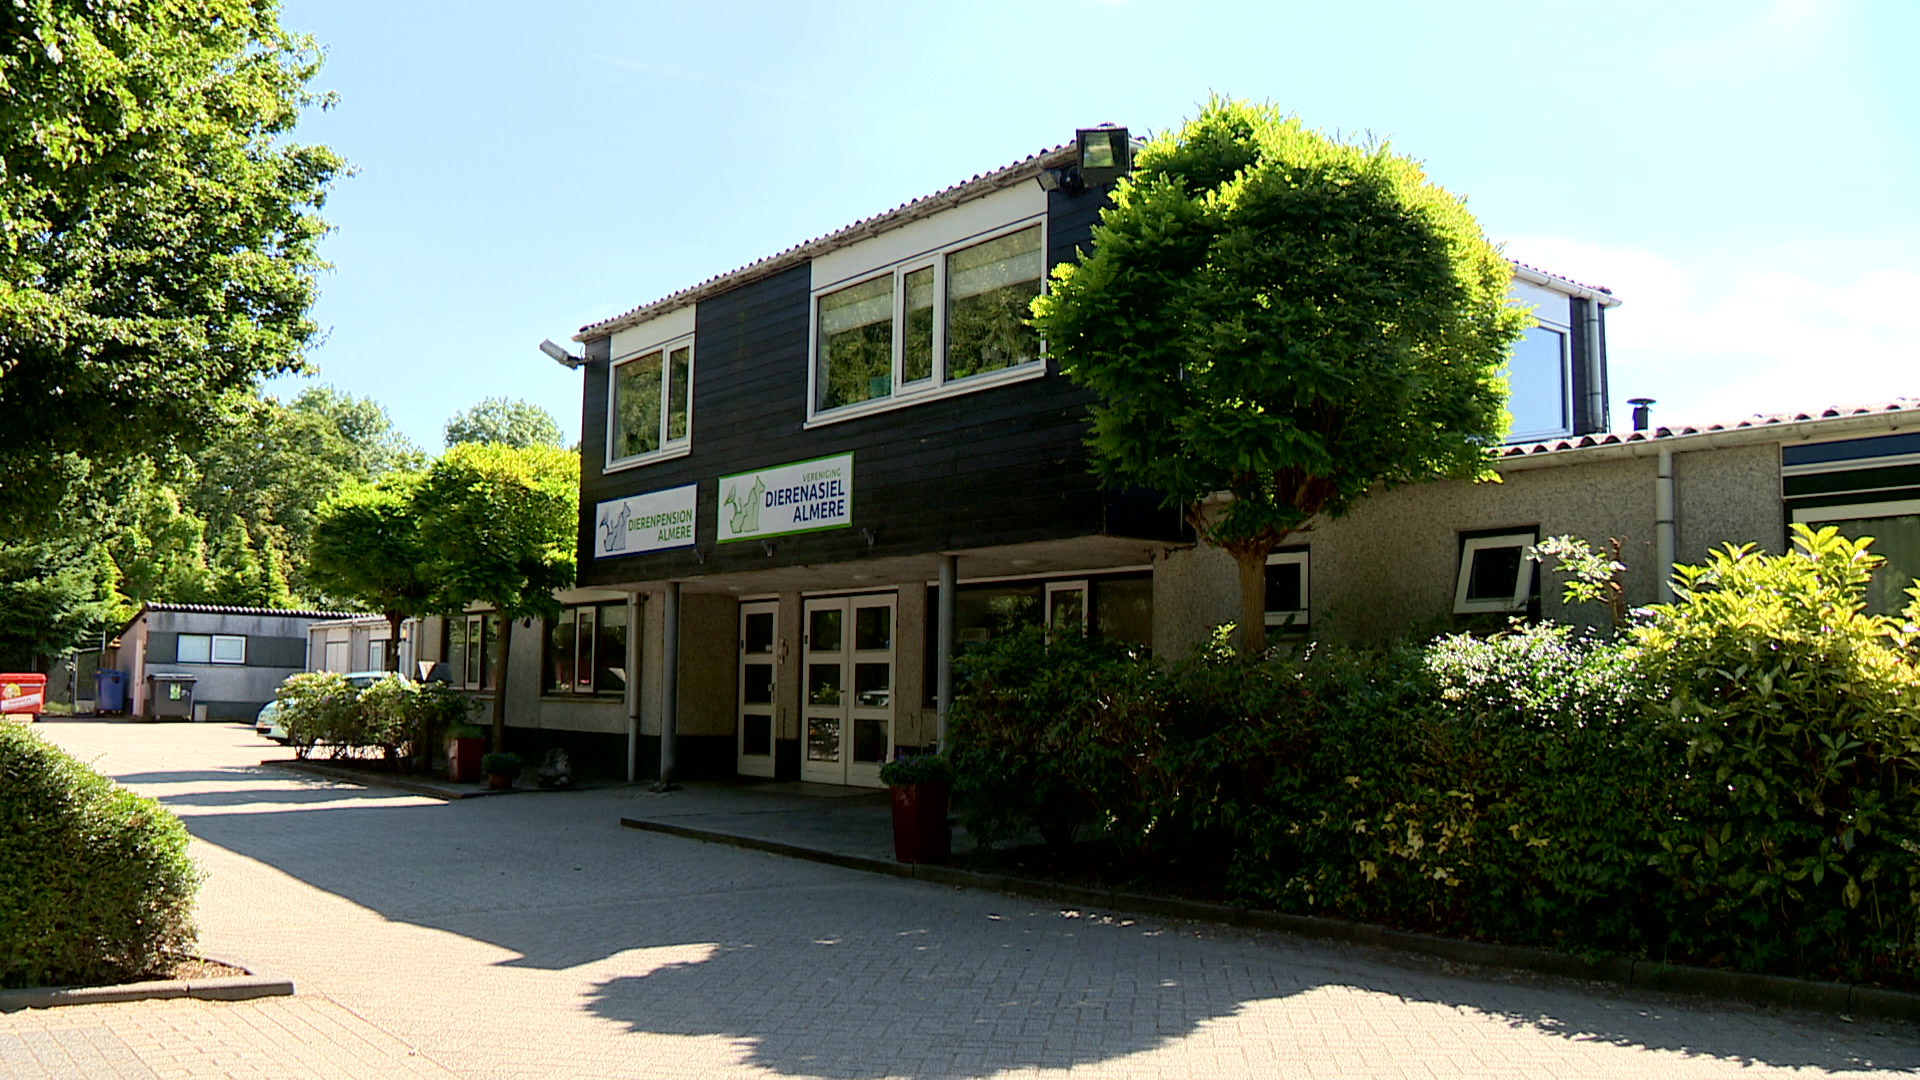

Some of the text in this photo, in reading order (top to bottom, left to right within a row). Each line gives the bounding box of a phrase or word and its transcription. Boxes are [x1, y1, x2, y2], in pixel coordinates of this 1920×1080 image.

[803, 468, 841, 482] VERENIGING
[765, 479, 845, 508] DIERENASIEL
[628, 509, 692, 531] DIERENPENSION
[793, 500, 845, 523] ALMERE
[658, 525, 692, 542] ALMERE
